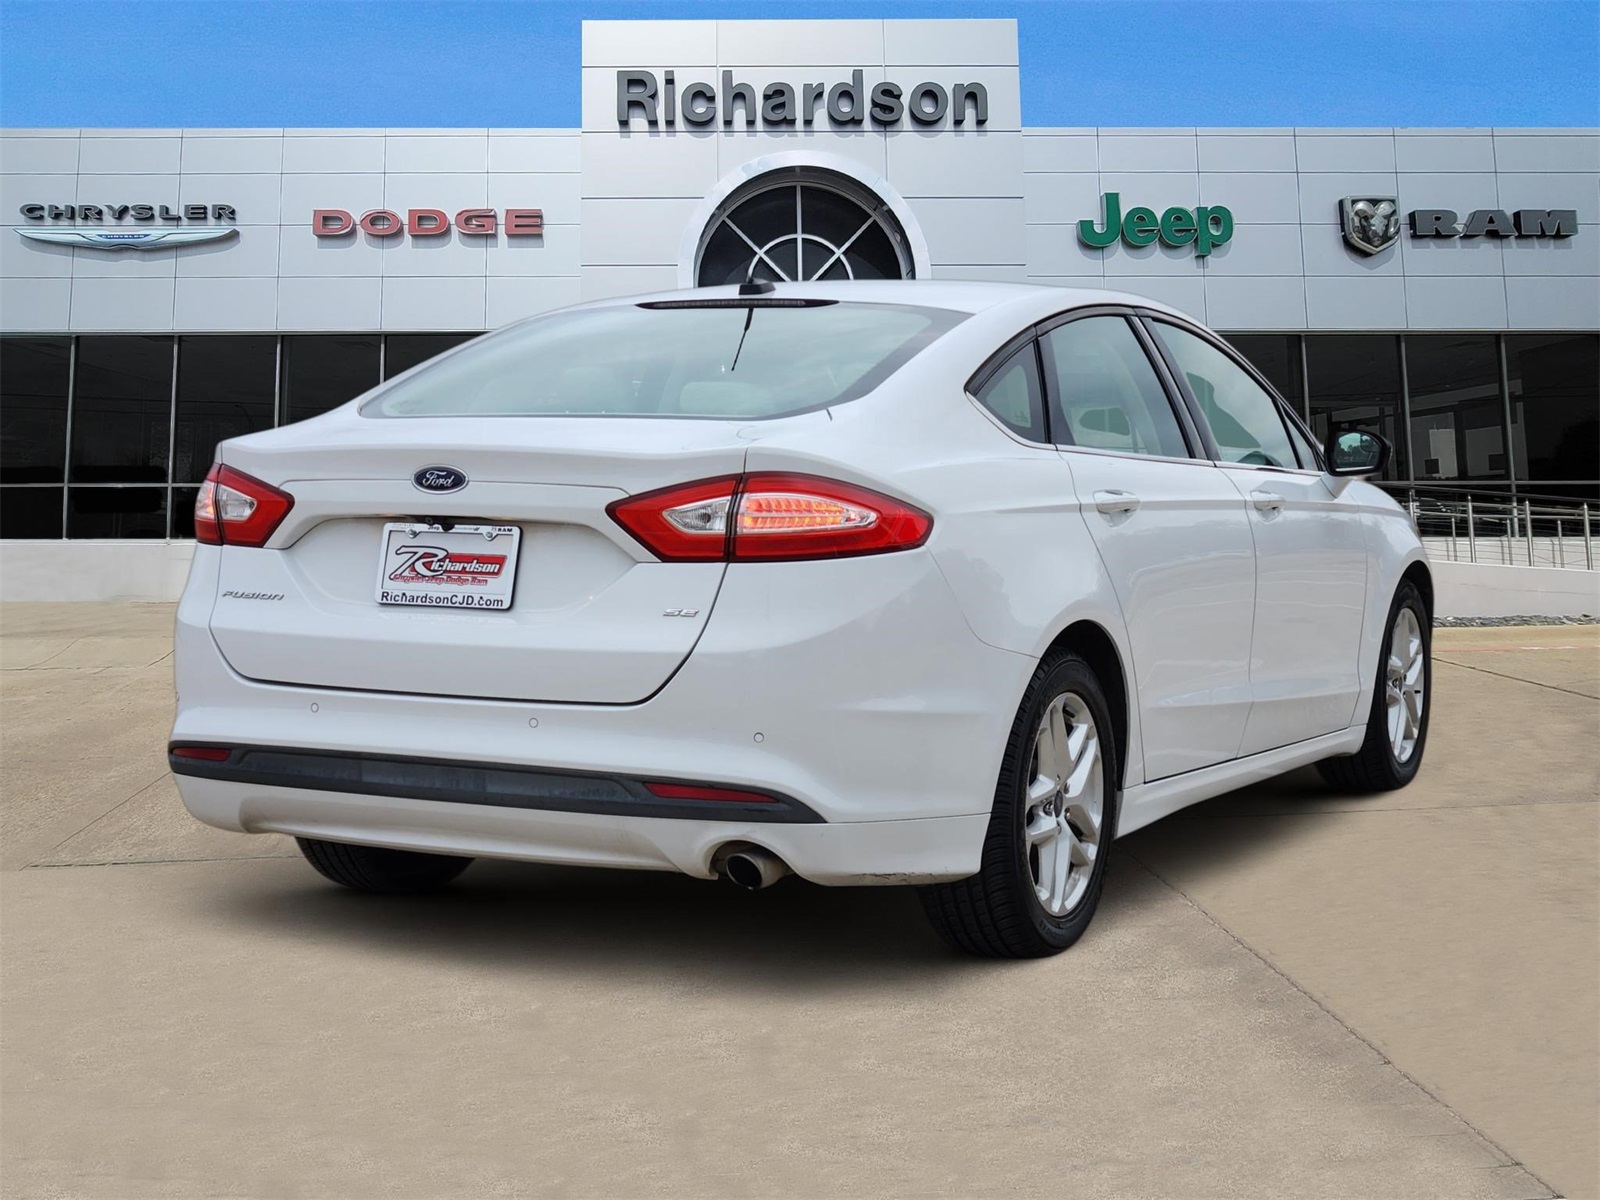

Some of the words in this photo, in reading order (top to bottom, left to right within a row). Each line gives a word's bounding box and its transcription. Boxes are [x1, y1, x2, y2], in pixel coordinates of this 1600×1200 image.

[616, 69, 988, 127] Richardson
[19, 203, 237, 221] CHRYSLER
[312, 208, 543, 236] DODGE
[1408, 209, 1579, 237] RAM
[1076, 192, 1234, 257] Jeep
[422, 470, 454, 487] Ford
[389, 545, 500, 580] Richardson
[222, 591, 285, 601] FUSION
[381, 591, 504, 607] RichardsonCJD.com
[663, 608, 699, 617] SE
